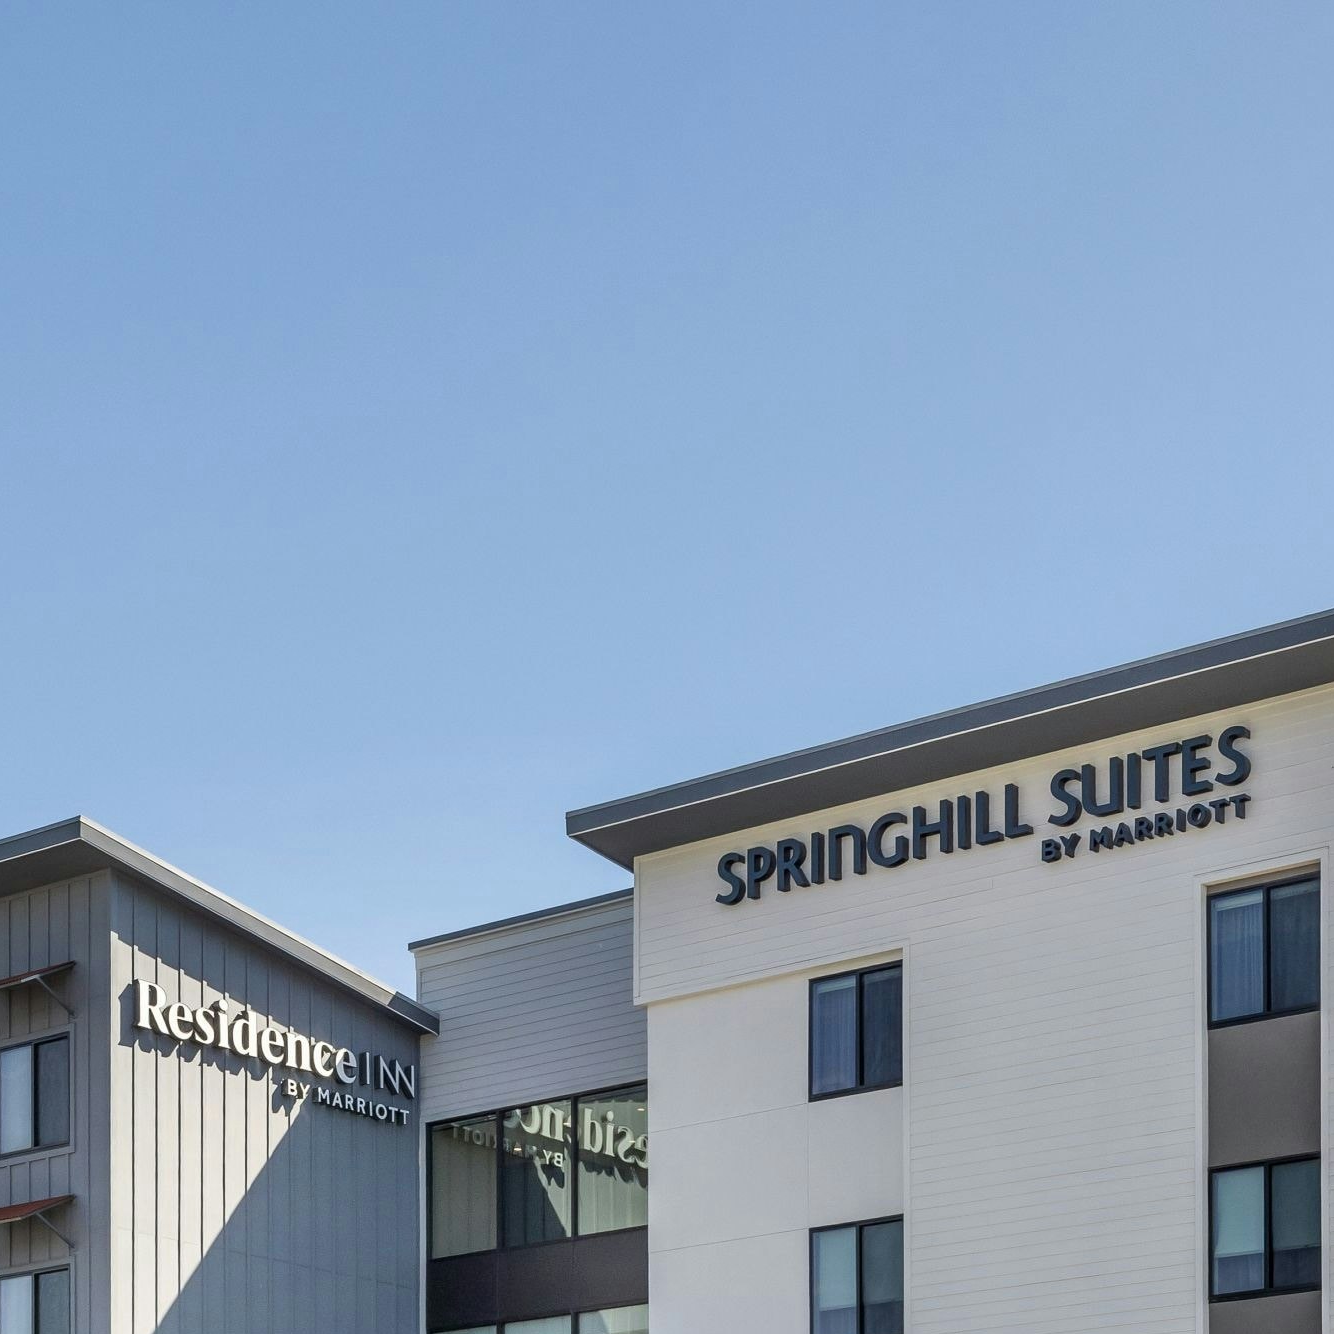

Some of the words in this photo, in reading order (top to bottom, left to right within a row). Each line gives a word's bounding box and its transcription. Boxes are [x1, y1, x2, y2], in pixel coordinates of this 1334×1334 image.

[716, 783, 1034, 906] SPRINGHILL
[1048, 725, 1252, 827] SUITES
[1041, 835, 1081, 863] BY
[1090, 793, 1252, 853] MARRIOTT
[134, 978, 358, 1084] Residence
[360, 1051, 415, 1099] INN
[284, 1078, 310, 1099] BY
[315, 1086, 410, 1125] MARRIOTT
